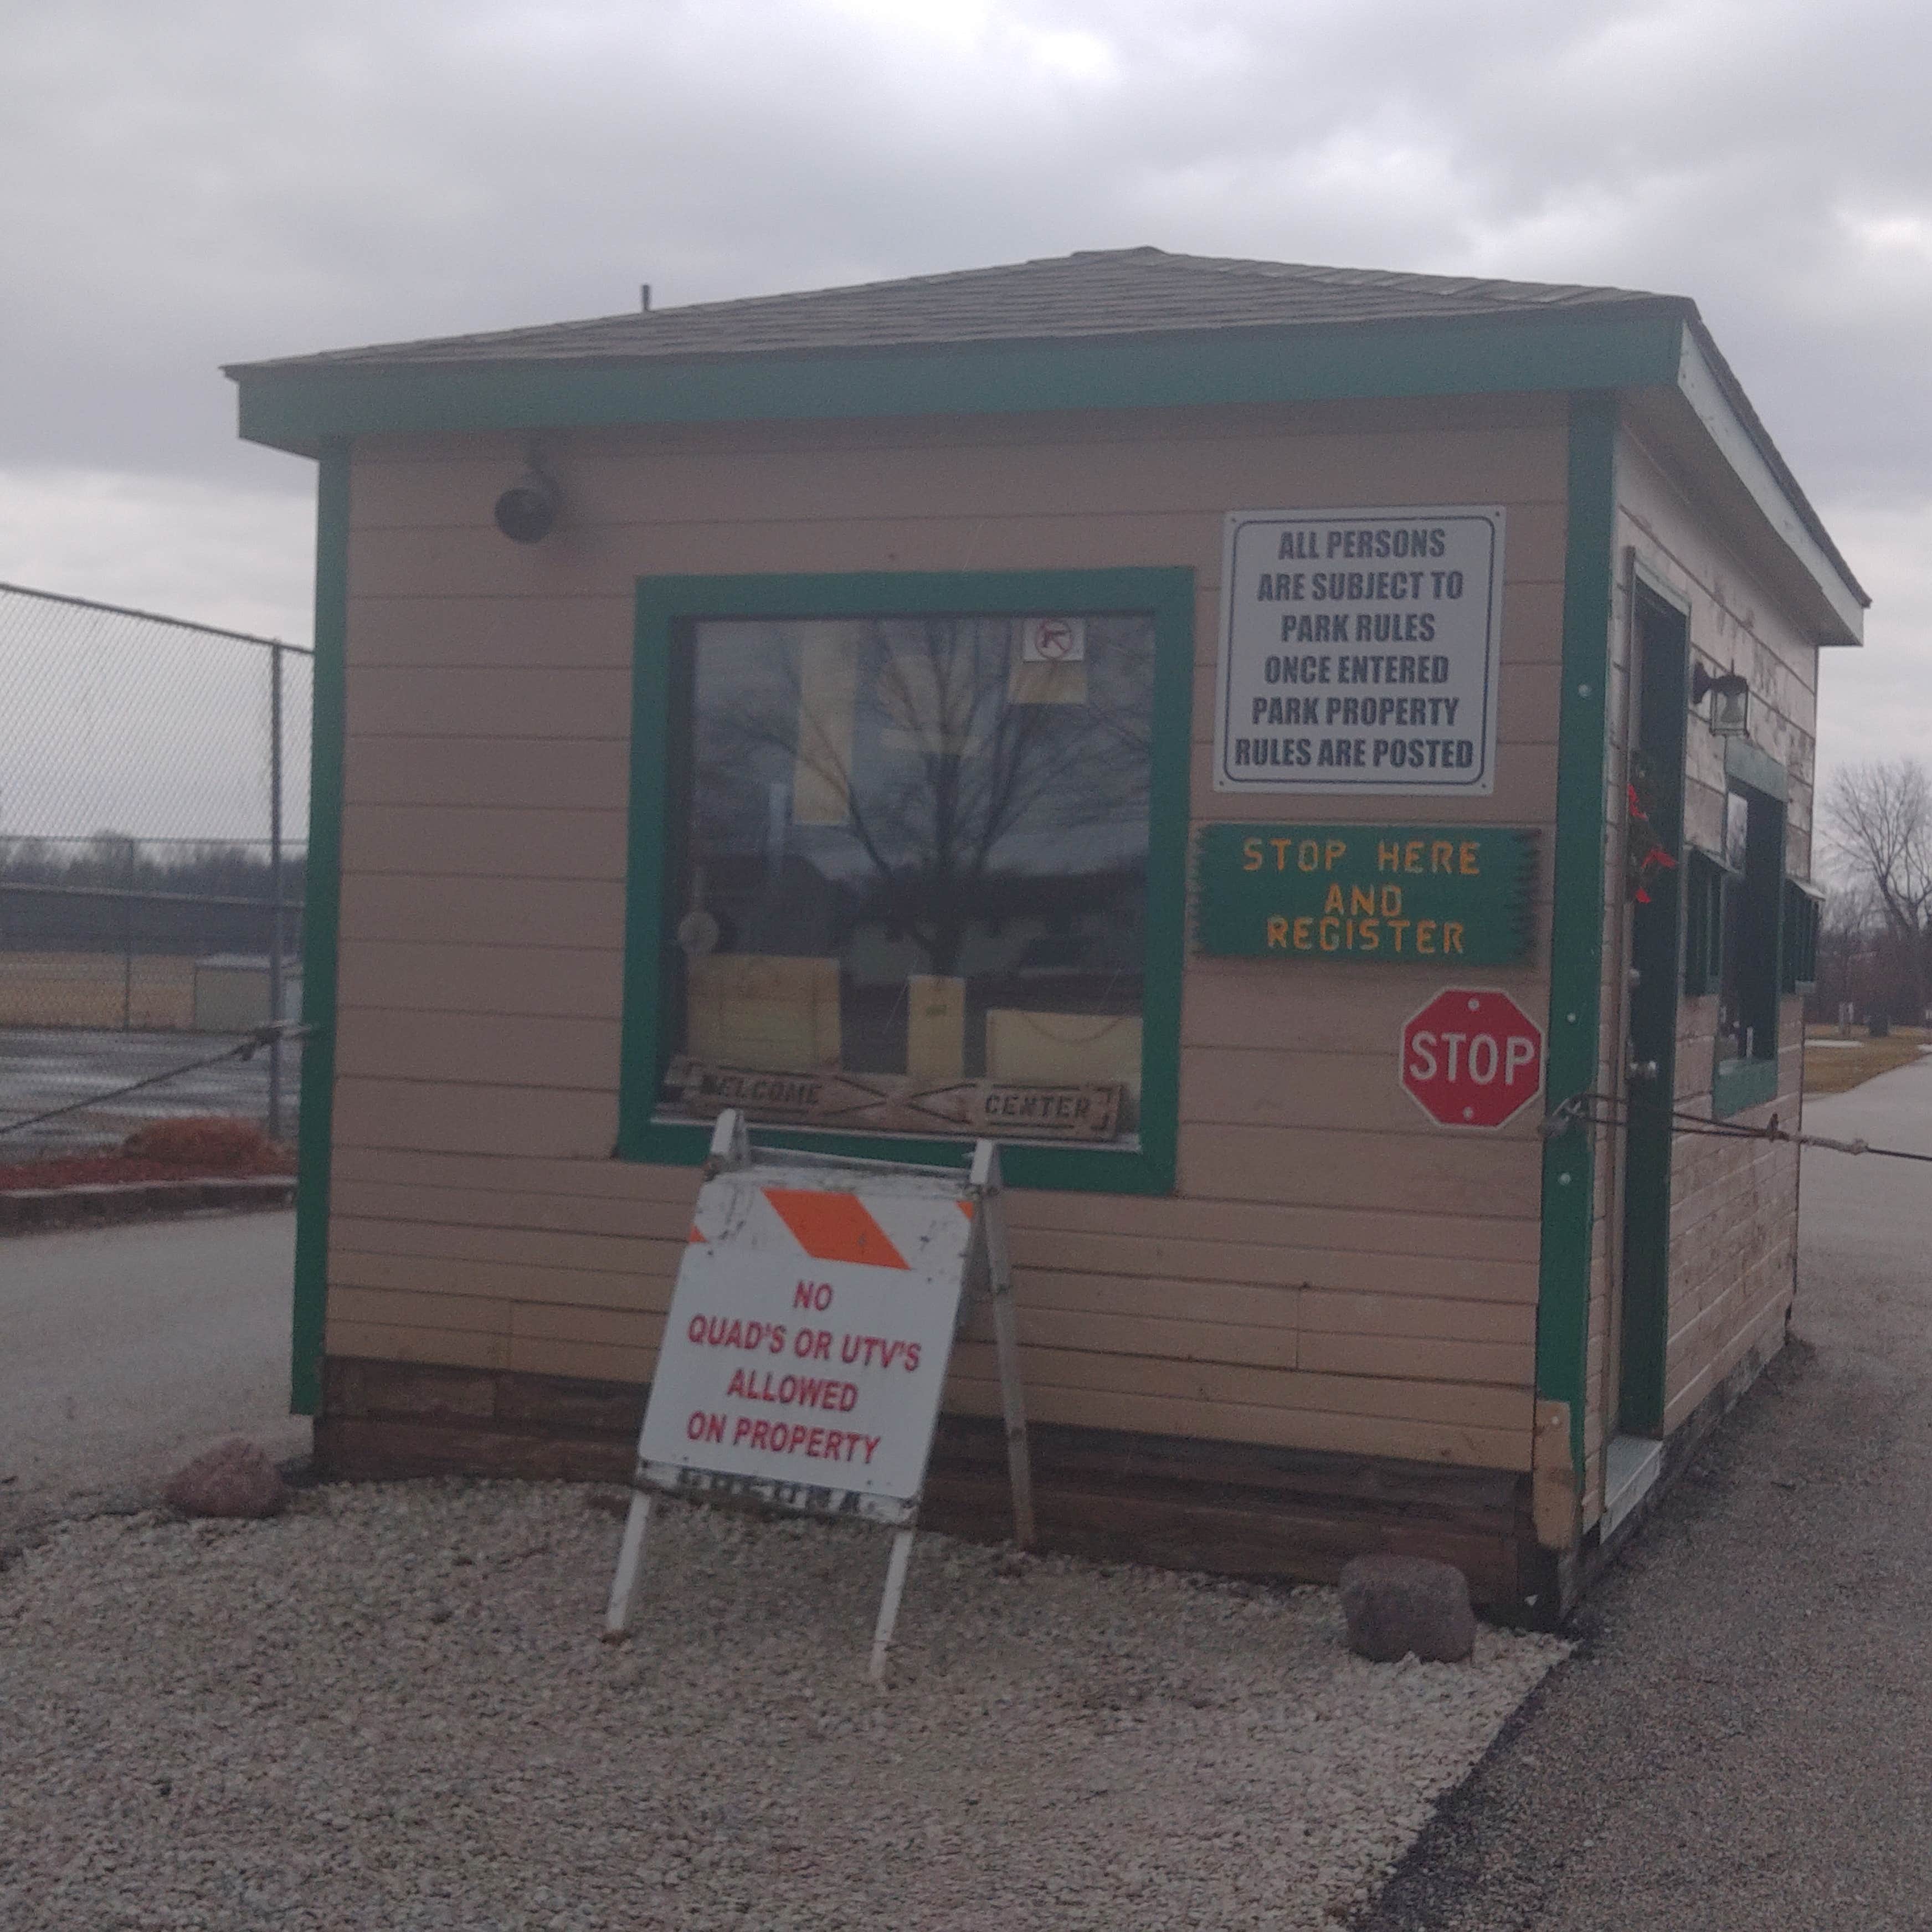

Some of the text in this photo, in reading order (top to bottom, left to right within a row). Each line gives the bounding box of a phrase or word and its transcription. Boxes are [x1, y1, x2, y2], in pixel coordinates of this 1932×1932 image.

[1278, 528, 1445, 559] ALL PERSONS
[1257, 571, 1463, 602] ARE SUBJECT TO
[1281, 613, 1435, 642] PARK RULES
[1265, 655, 1449, 684] ONCE ENTERED
[1252, 697, 1460, 726] PARK PROPERTY
[1235, 738, 1473, 768] RULES ARE POSTED
[1242, 838, 1481, 875] STOP HERE
[1324, 883, 1402, 917] AND
[1266, 916, 1463, 953] REGISTER
[1410, 1031, 1534, 1085] STOP
[985, 1095, 1091, 1117] CENTER
[793, 1280, 834, 1311] NO
[687, 1314, 922, 1372] QUAD'S OR UTV'S
[727, 1369, 858, 1412] ALLOWED
[687, 1411, 881, 1465] ON PROPERTY
